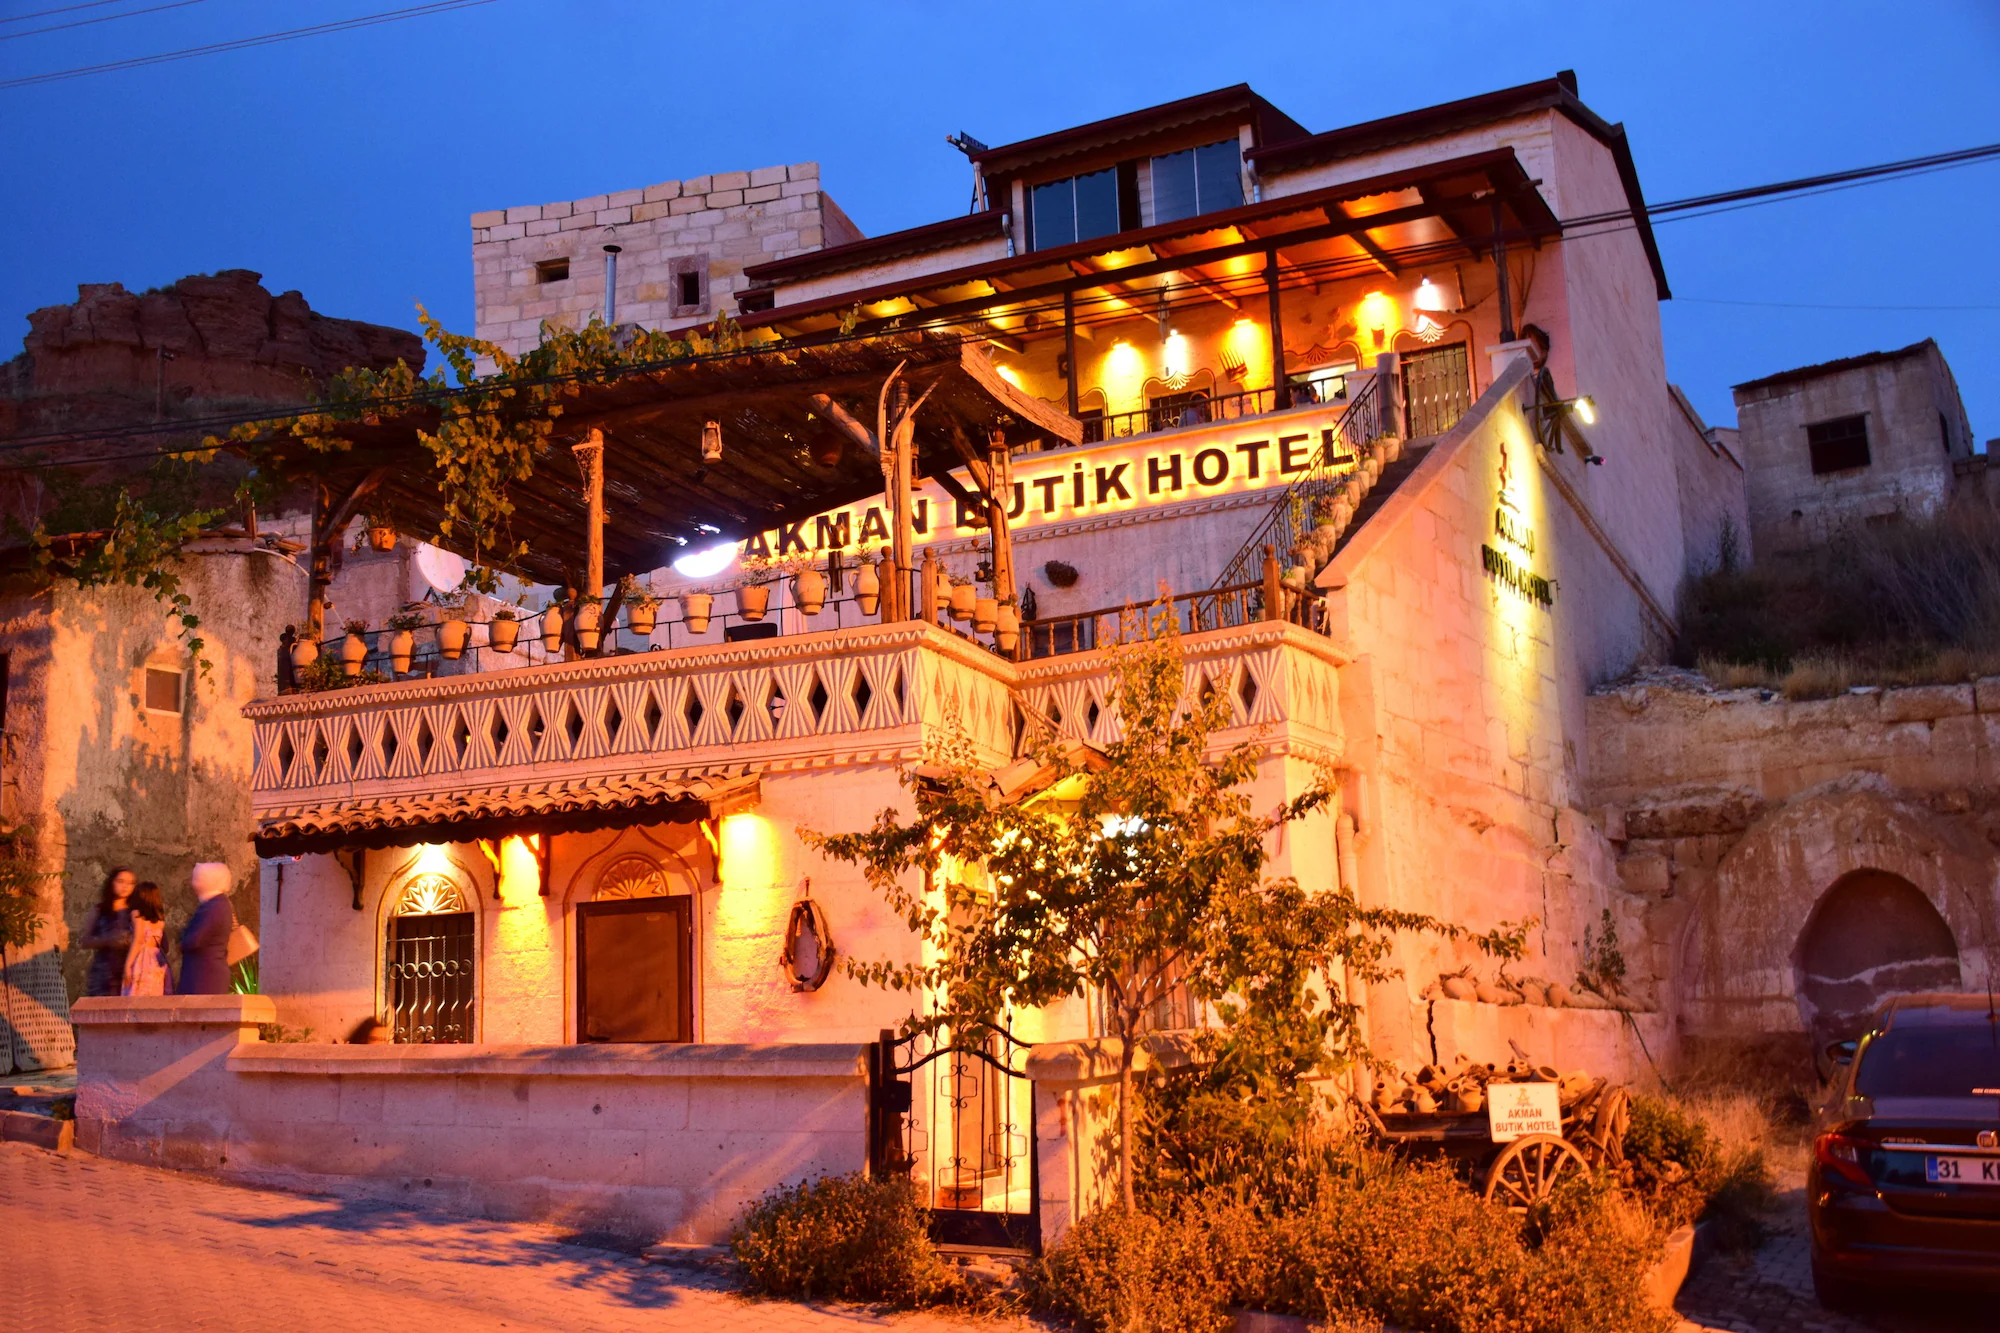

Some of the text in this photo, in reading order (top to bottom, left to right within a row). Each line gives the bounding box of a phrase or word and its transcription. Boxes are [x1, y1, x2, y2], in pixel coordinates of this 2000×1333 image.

[1147, 428, 1354, 495] HOTEL
[1508, 1108, 1542, 1118] AKMAN
[1527, 1121, 1557, 1131] HOTEL
[1938, 1160, 1961, 1179] 31
